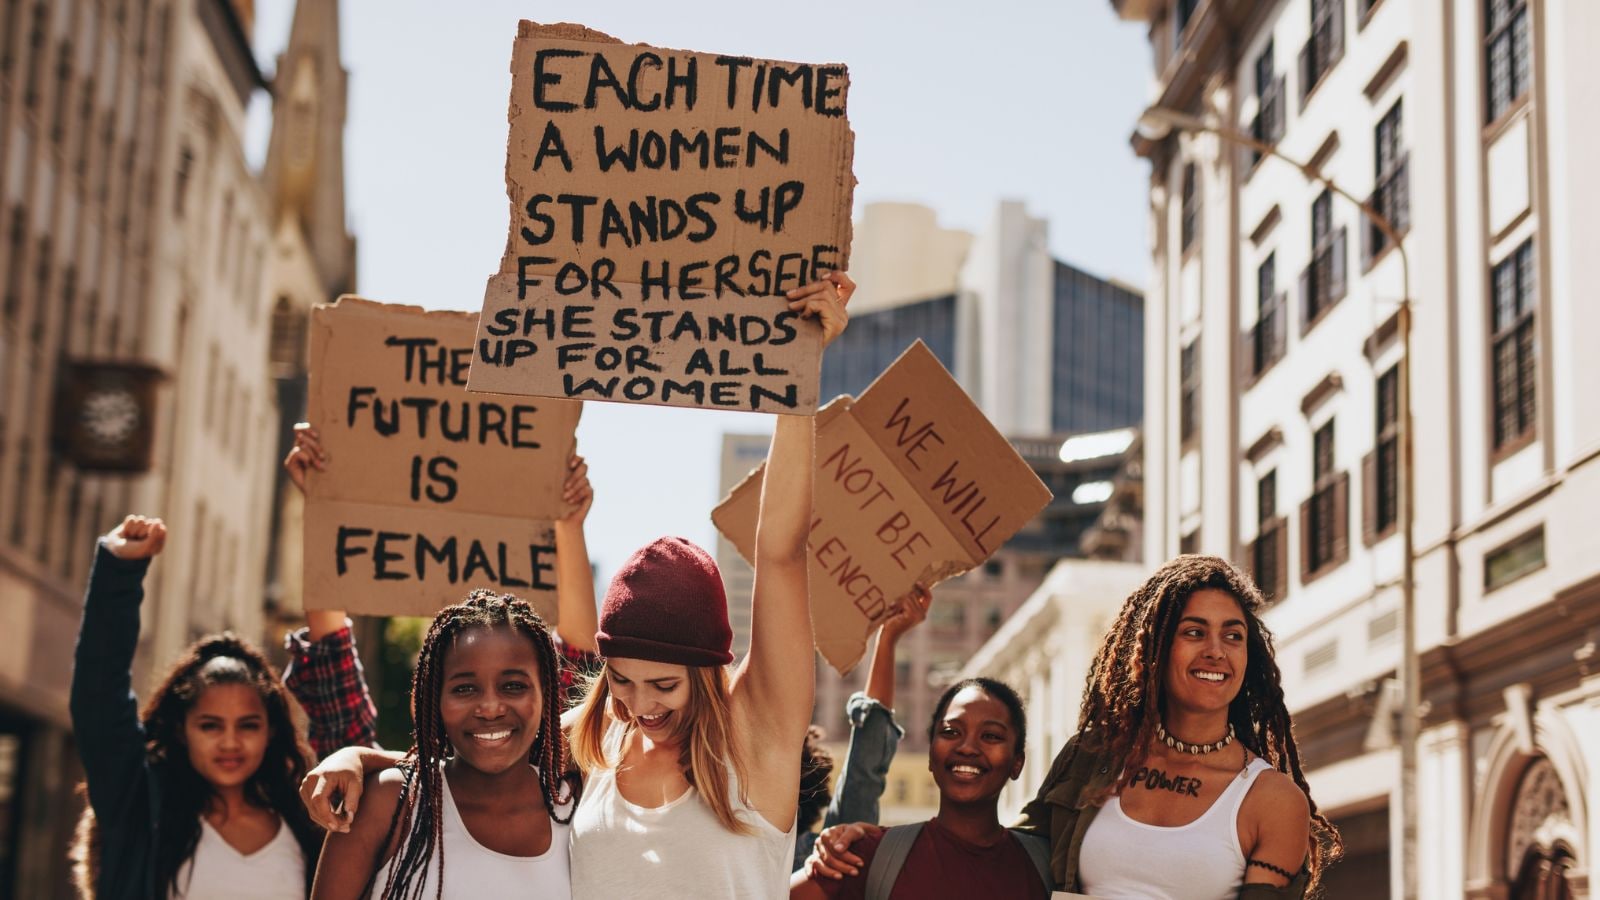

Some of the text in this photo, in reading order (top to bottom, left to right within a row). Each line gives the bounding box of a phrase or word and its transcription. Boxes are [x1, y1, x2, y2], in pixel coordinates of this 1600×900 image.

[533, 48, 844, 119] EACH TIME
[532, 119, 790, 173] A WOMEN
[520, 180, 805, 249] STANDS UP
[516, 256, 622, 301] FOR
[486, 305, 799, 347] SHE STANDS
[384, 335, 474, 386] THE
[479, 338, 789, 376] UP FOR ALL
[347, 386, 541, 449] FUTURE
[563, 373, 798, 410] WOMEN
[410, 455, 458, 504] IS
[884, 397, 1001, 556] WE WILL
[820, 443, 933, 571] NOT BE
[335, 526, 557, 591] FEMALE
[1129, 765, 1203, 798] POWER
